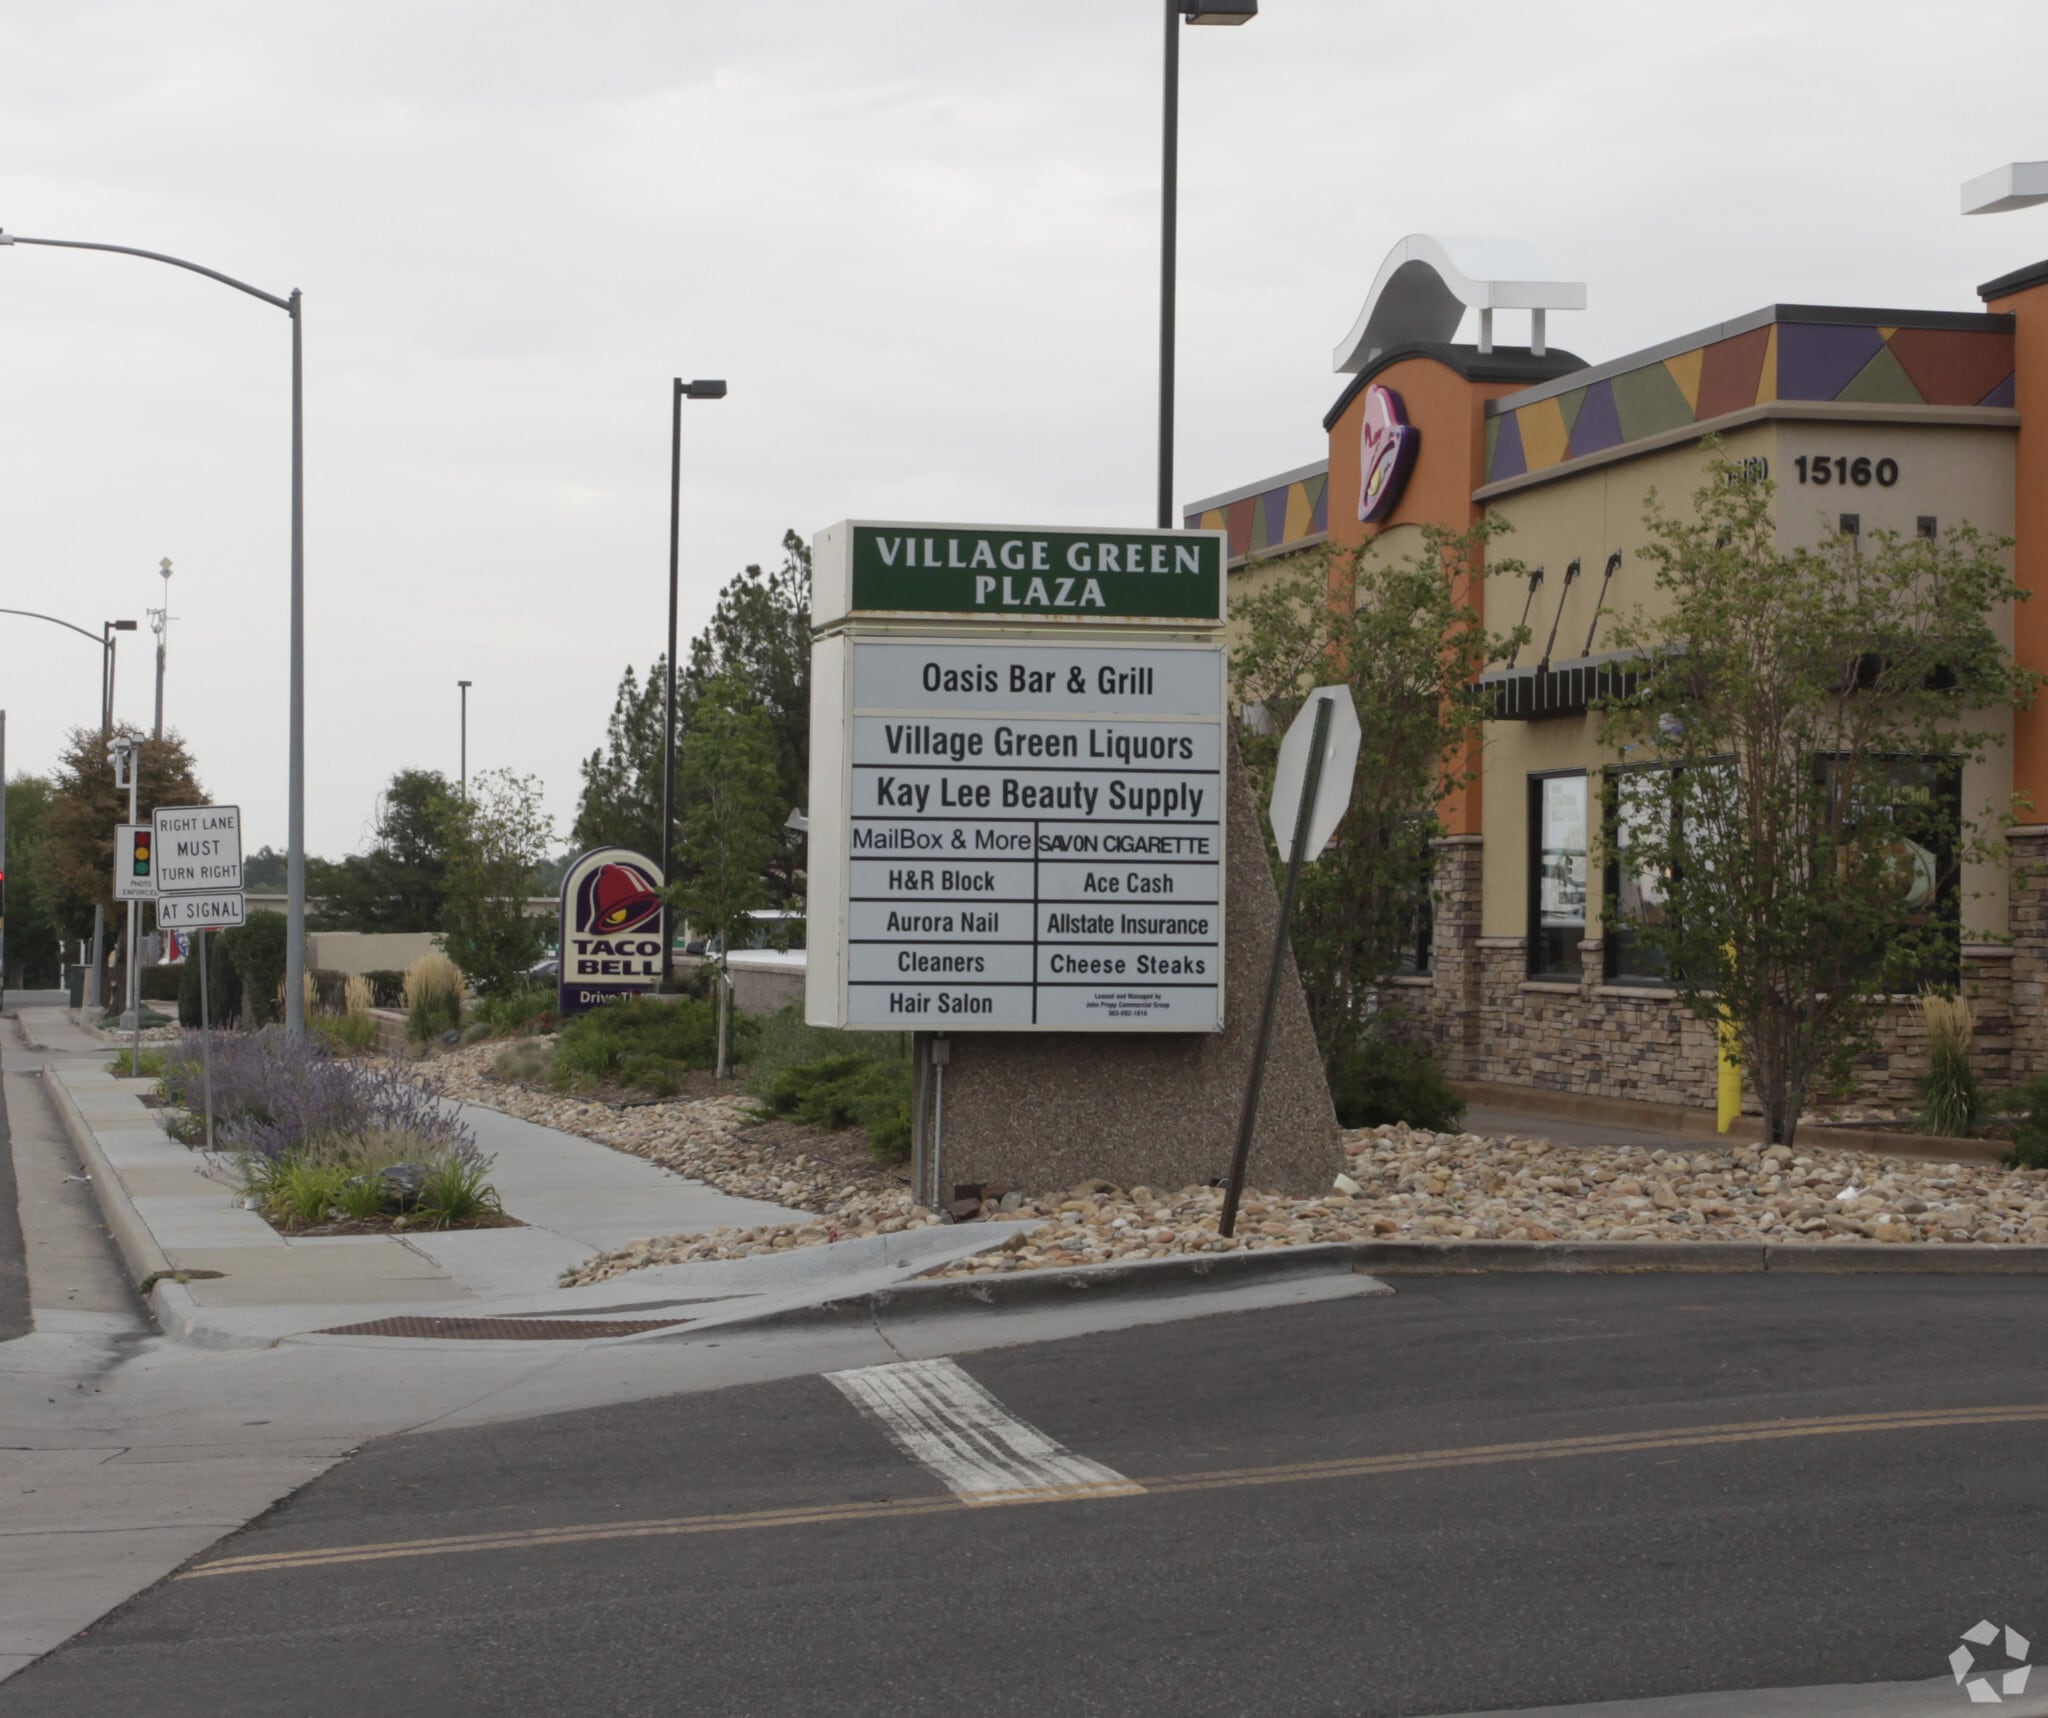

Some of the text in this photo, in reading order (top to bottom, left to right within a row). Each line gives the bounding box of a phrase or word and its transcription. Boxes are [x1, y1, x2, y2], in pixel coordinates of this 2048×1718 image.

[1795, 456, 1899, 487] 15160
[875, 537, 1201, 575] VILLAGE GREEN
[975, 576, 1106, 607] PLAZA
[922, 662, 1154, 696] Oasis Bar & Grill
[885, 724, 1193, 765] Village Green Liquors
[877, 776, 1204, 817] Kay Lee Beauty Supply
[160, 816, 234, 832] RIGHT LANE
[177, 840, 220, 856] MUST
[853, 828, 1031, 851] MailBox & More
[1103, 835, 1210, 855] CIGARETTE
[161, 865, 237, 880] TURN RIGHT
[889, 870, 995, 893] H&R Block
[1084, 872, 1174, 895] Ace Cash
[163, 901, 239, 920] AT SIGNAL
[886, 911, 999, 934] Aurora Nail
[1047, 913, 1209, 936] Allstate Insurance
[572, 940, 661, 956] TACO
[577, 960, 662, 976] BELL
[898, 951, 985, 973] Cleaners
[1050, 954, 1206, 975] Cheese Steaks
[889, 993, 993, 1015] Hair Salon
